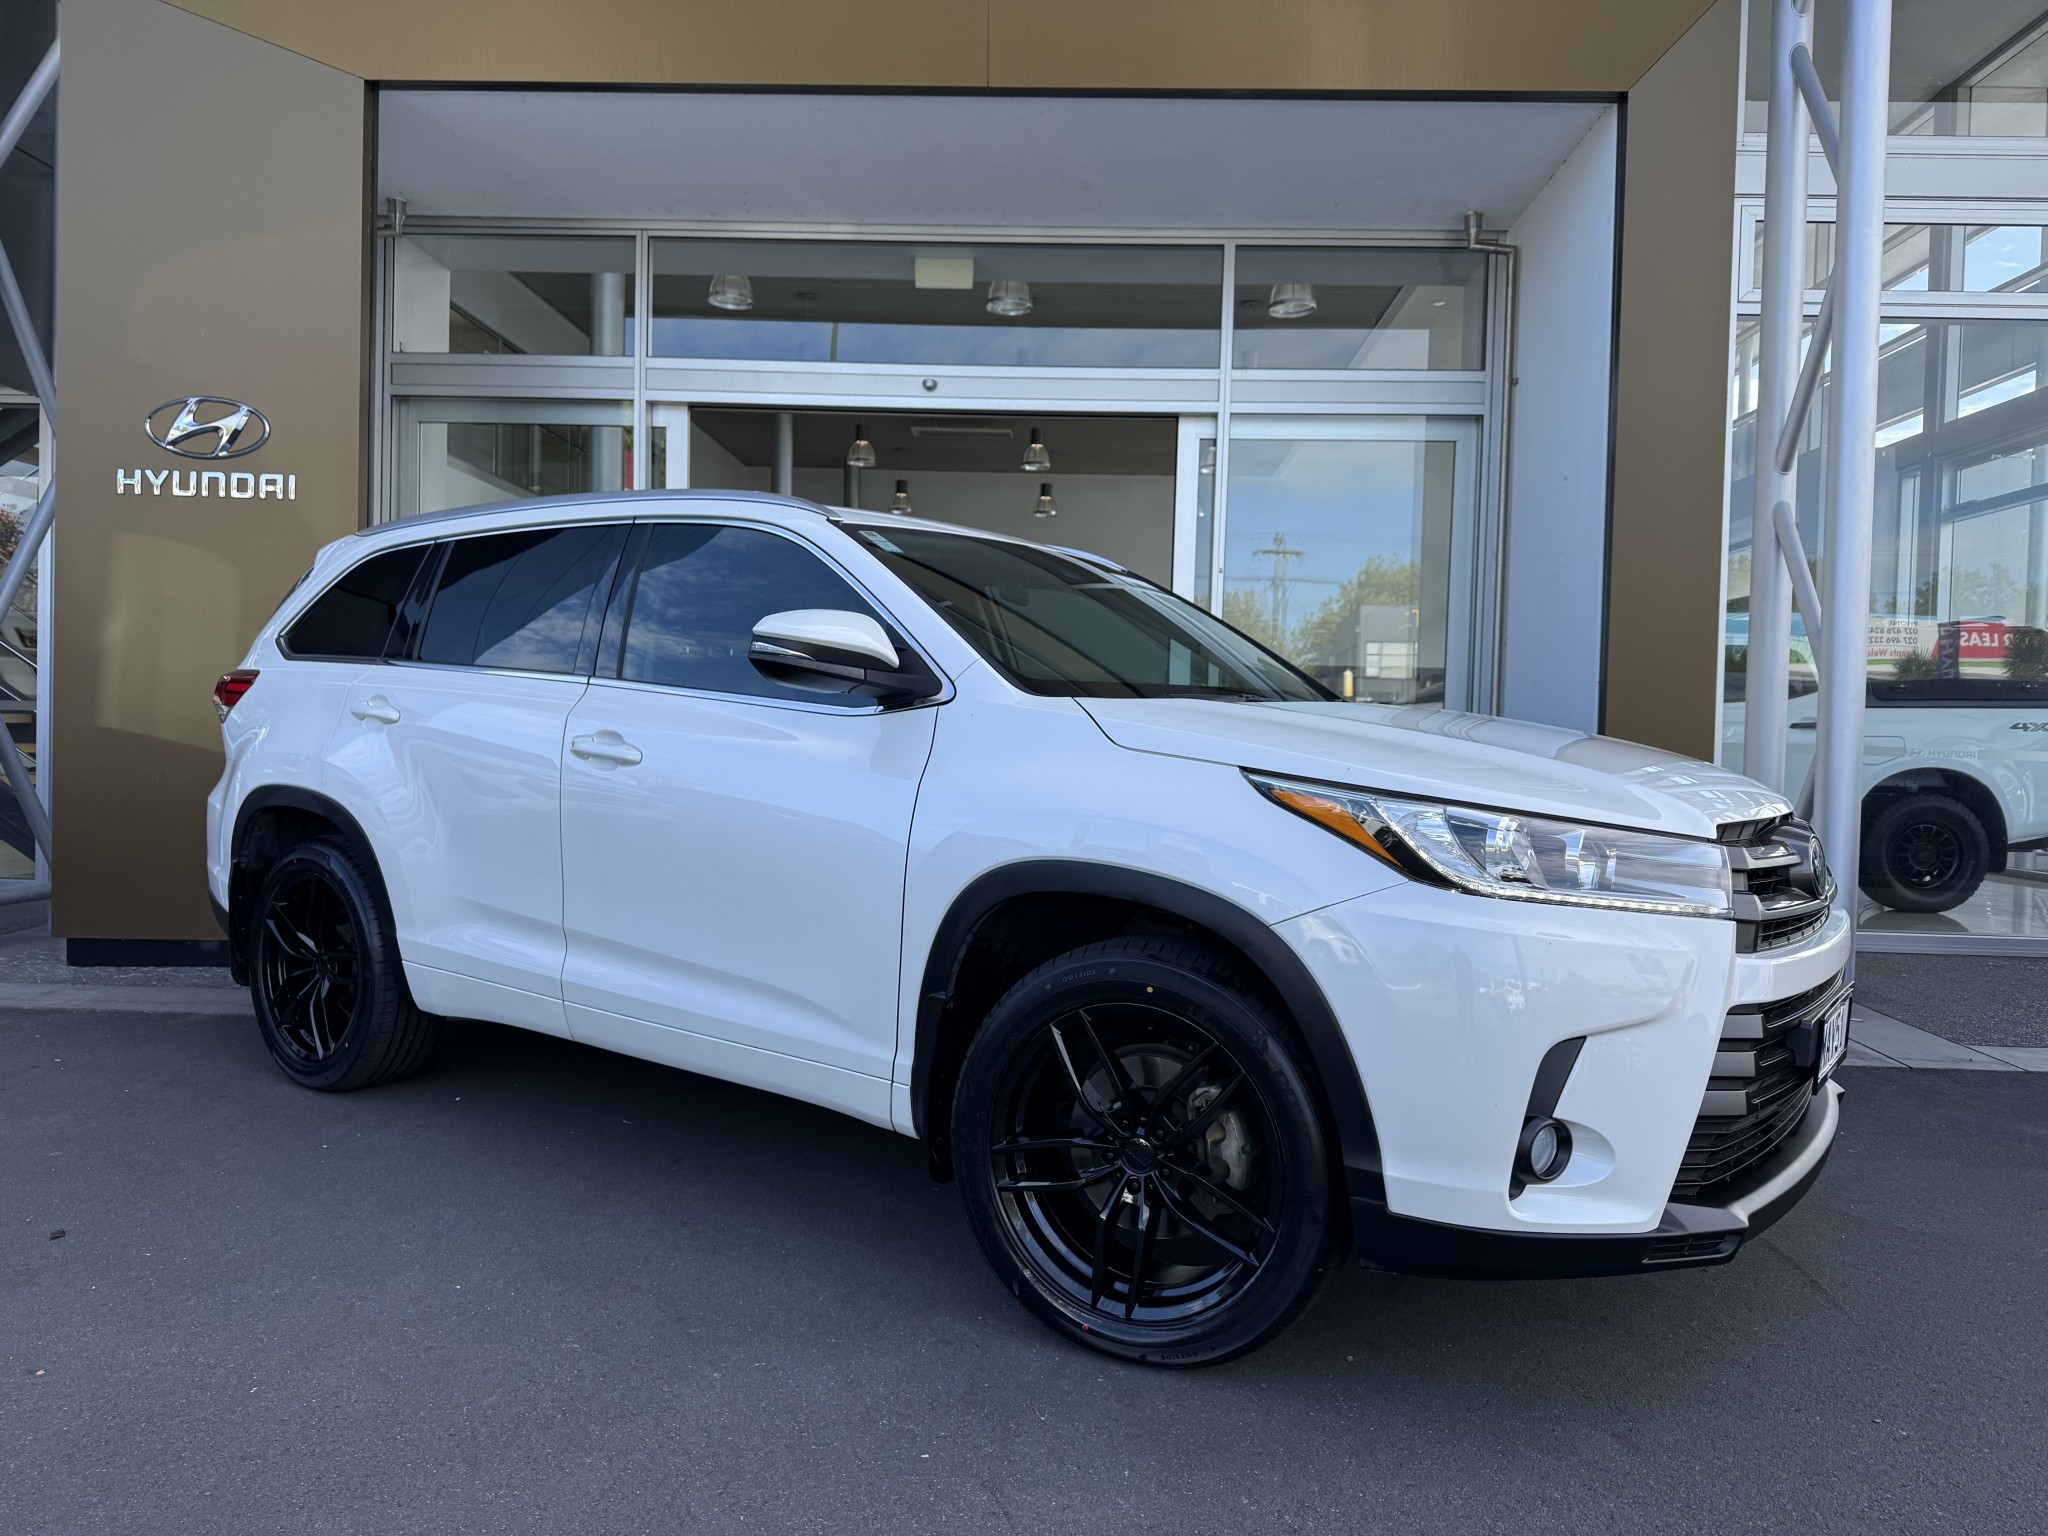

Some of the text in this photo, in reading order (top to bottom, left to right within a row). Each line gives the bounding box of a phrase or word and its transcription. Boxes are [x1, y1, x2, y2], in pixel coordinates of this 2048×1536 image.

[116, 468, 297, 501] HYUNDAI
[1928, 749, 1976, 759] HYUNDAI
[1062, 969, 1097, 983] OUTSIDE
